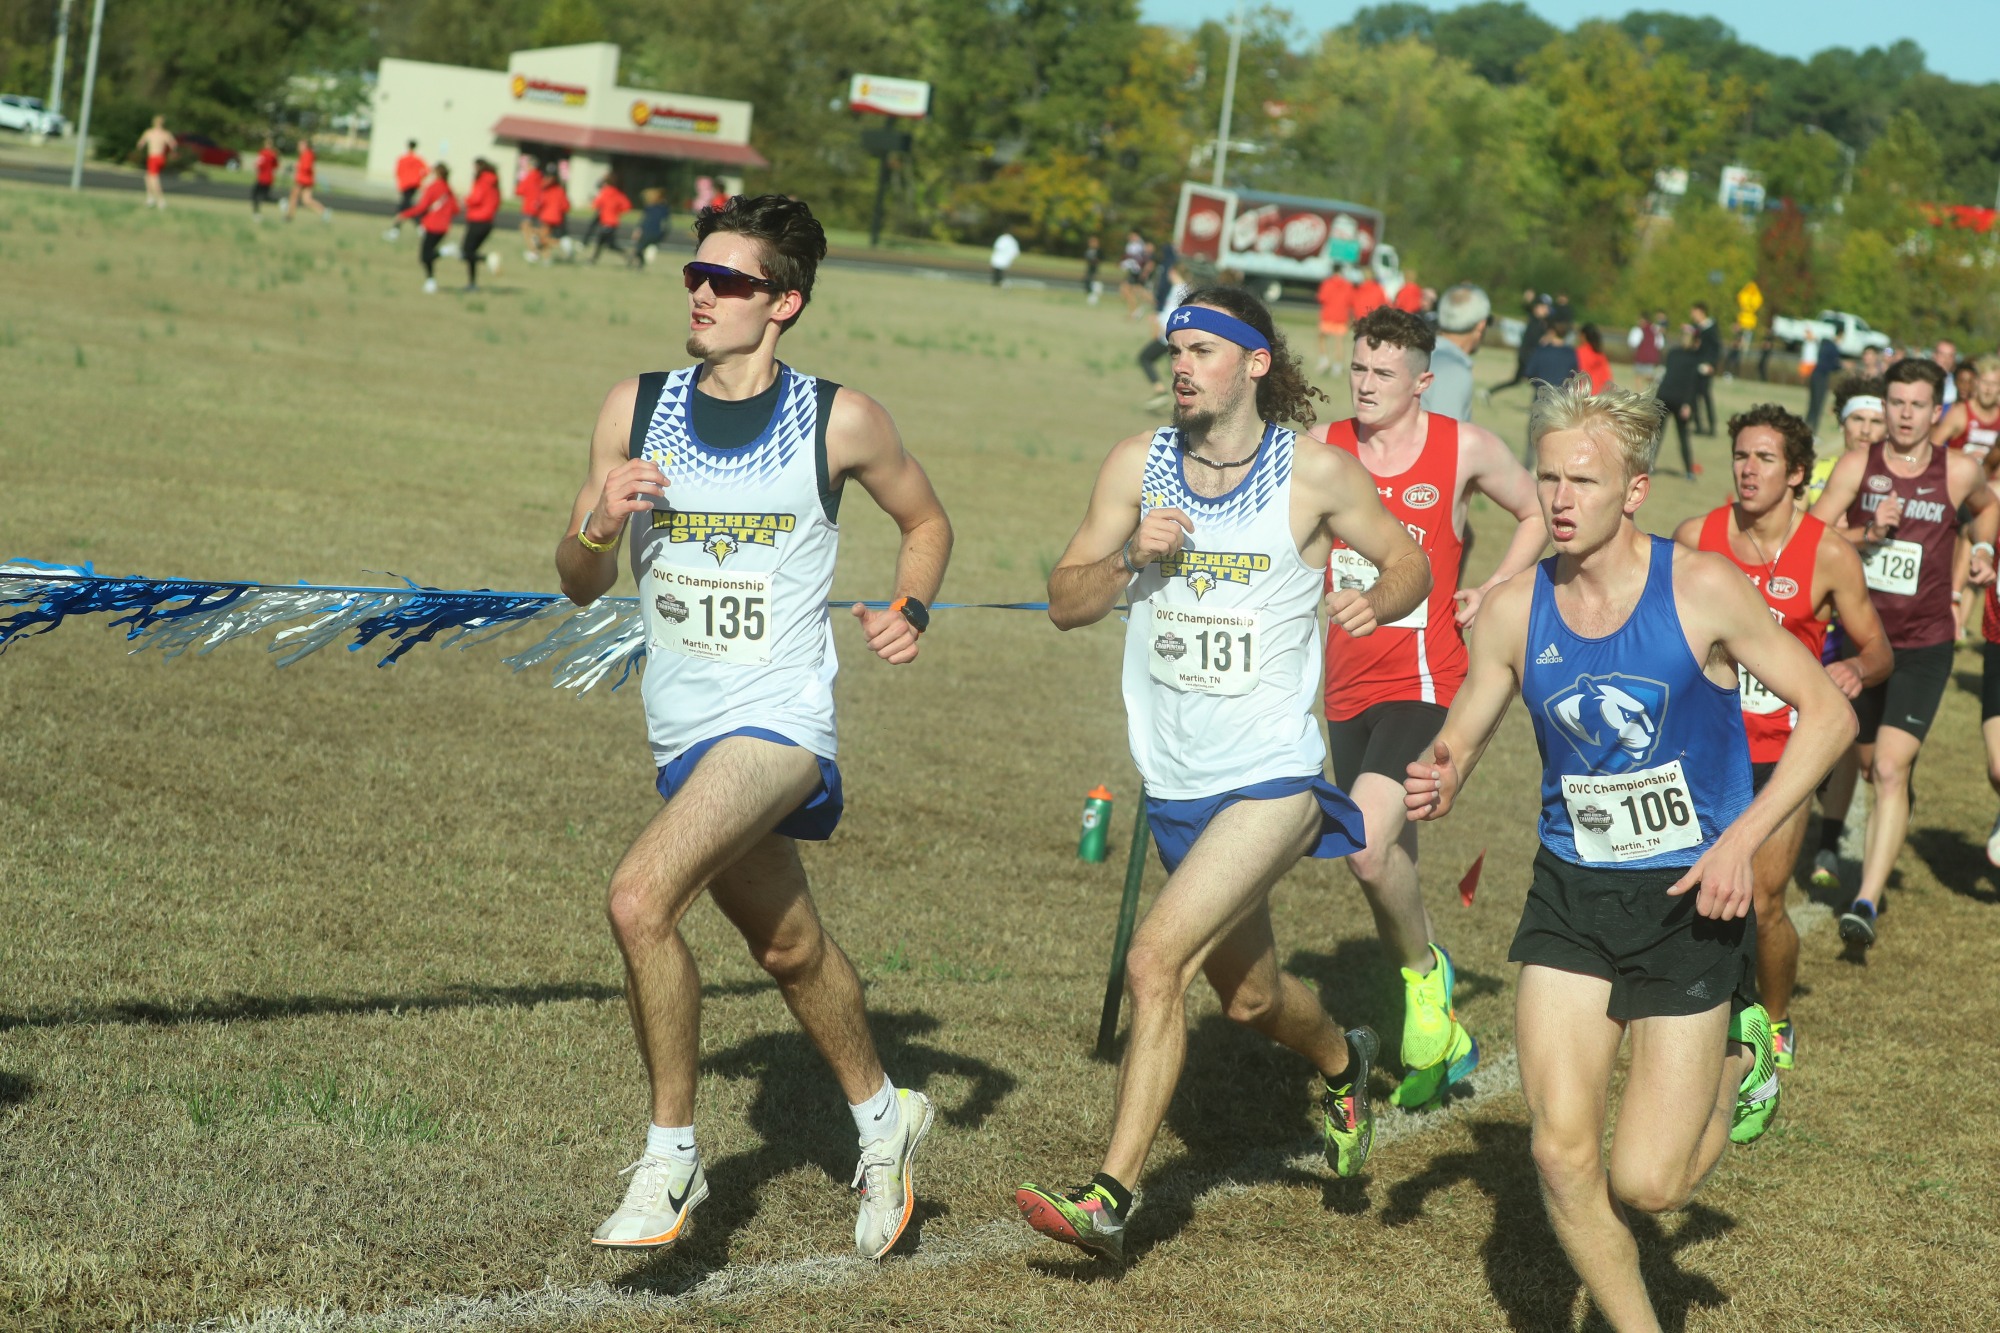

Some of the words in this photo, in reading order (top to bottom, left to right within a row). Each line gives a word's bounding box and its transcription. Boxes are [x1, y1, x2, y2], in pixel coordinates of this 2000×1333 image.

[1410, 491, 1432, 501] OVC
[1862, 493, 1905, 513] LITE
[1905, 499, 1946, 523] ROCK
[653, 510, 796, 533] MOREHEAD
[1153, 550, 1270, 572] OREHEAD
[1338, 555, 1354, 565] OVC
[1881, 554, 1915, 580] 128
[653, 568, 673, 583] OVC
[677, 574, 765, 592] Championship
[699, 594, 765, 640] 135
[1156, 609, 1174, 621] OVC
[1177, 611, 1254, 628] Championship
[682, 637, 712, 652] Martin,
[715, 643, 728, 652] TN
[1195, 630, 1251, 672] 131
[1535, 656, 1563, 665] adidas
[1179, 673, 1207, 684] Martin,
[1209, 676, 1221, 684] TN
[1741, 670, 1778, 697] 14
[1569, 783, 1591, 794] OVC
[1593, 772, 1676, 794] Championship
[1620, 787, 1690, 835] 106
[1611, 841, 1645, 852] Martin,
[1646, 837, 1661, 846] TN
